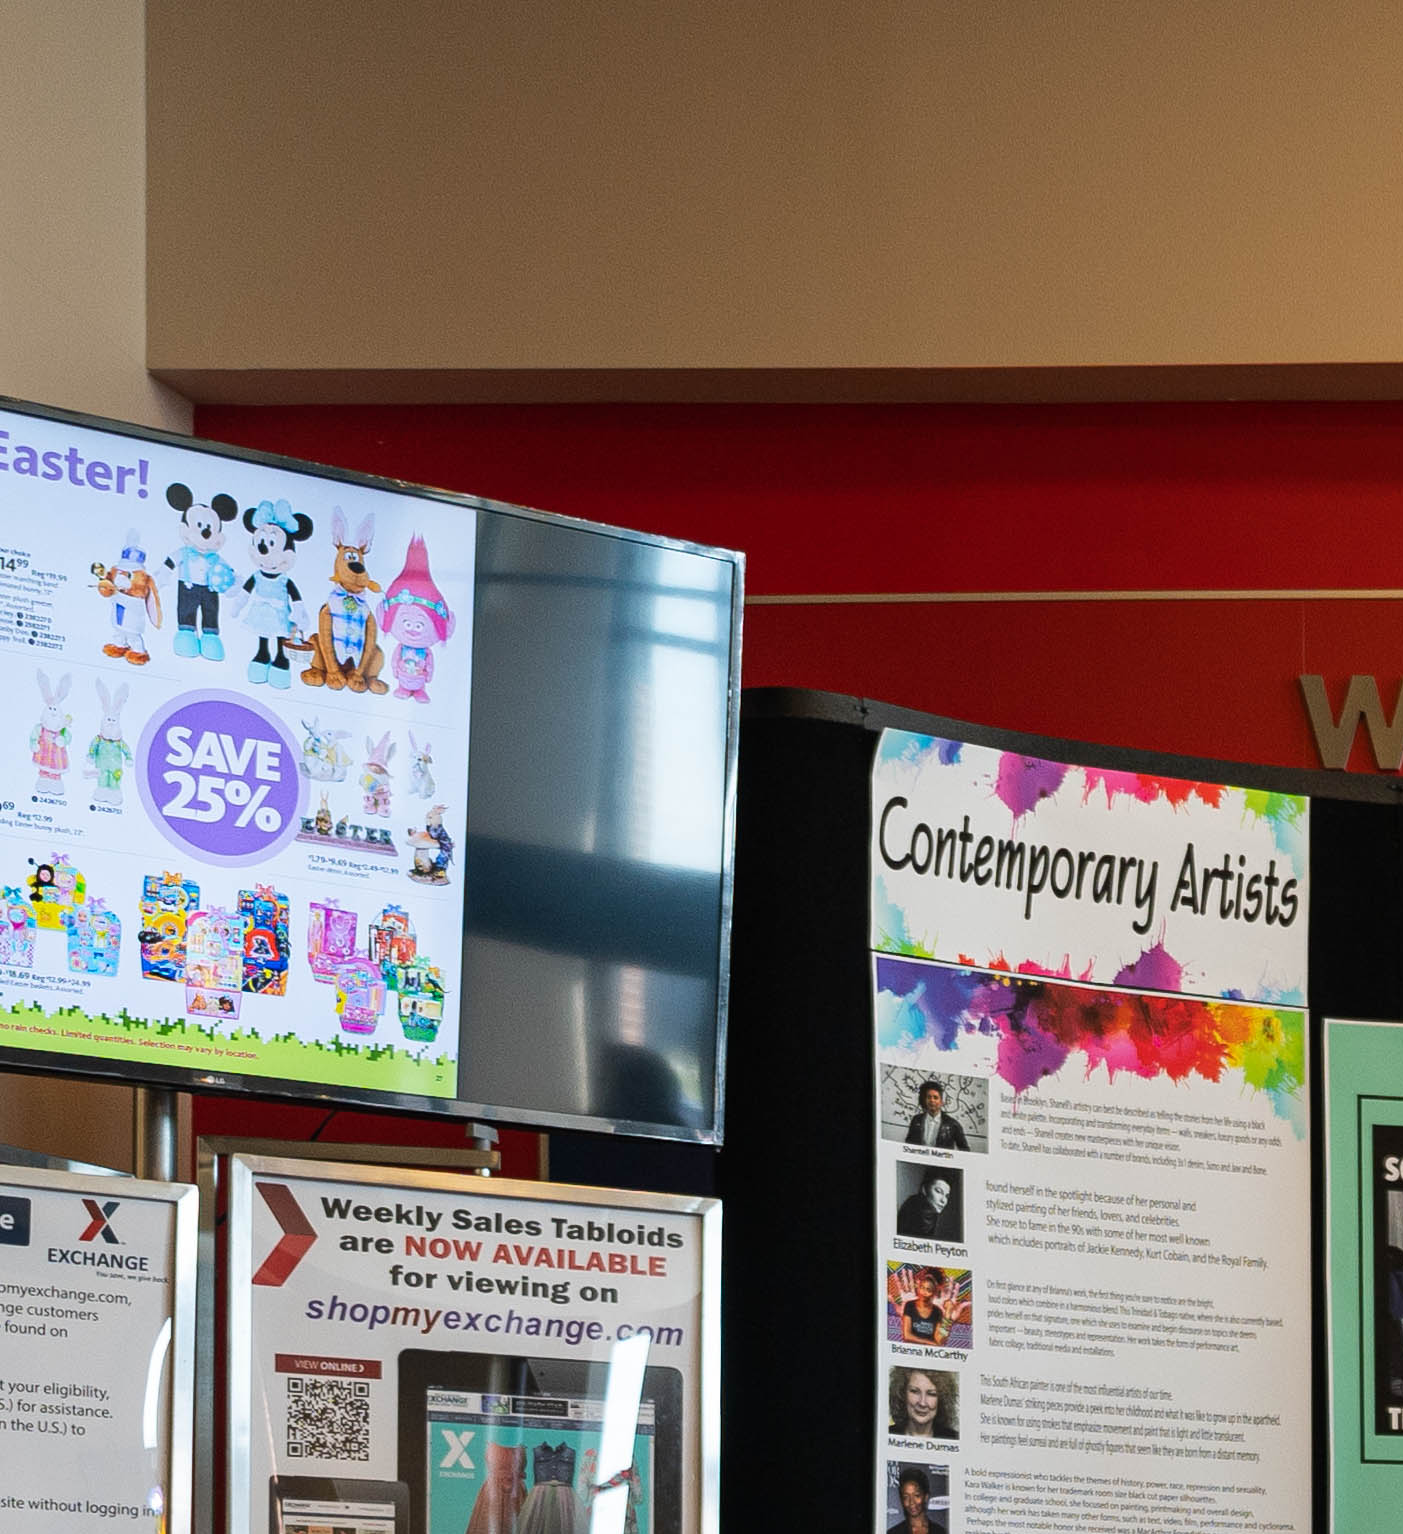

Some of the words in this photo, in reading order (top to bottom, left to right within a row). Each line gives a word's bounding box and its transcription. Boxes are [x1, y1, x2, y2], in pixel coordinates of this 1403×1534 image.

[166, 726, 282, 782] SAVE
[162, 770, 282, 832] 25%
[879, 795, 1159, 935] Contemporary
[1170, 842, 1299, 928] Artists
[61, 1029, 91, 1040] Limited
[139, 1038, 175, 1049] Selection
[1150, 1200, 1181, 1210] personal
[321, 1197, 443, 1232] Weekly
[452, 1208, 542, 1237] Sales
[552, 1217, 684, 1249] Tabloids
[340, 1234, 395, 1254] are
[405, 1236, 483, 1262] NOW
[493, 1244, 667, 1277] AVAILABLE
[893, 1238, 932, 1257] Elizabeth
[935, 1243, 968, 1259] Peyton
[47, 1248, 149, 1272] EXCHANGE
[390, 1265, 438, 1290] for
[447, 1271, 571, 1305] viewing
[579, 1282, 619, 1304] on
[27, 1305, 99, 1321] customers
[306, 1295, 684, 1346] shopmyexchange.com
[5, 1320, 45, 1335] found
[50, 1327, 67, 1337] on
[294, 1360, 319, 1371] VIEW
[320, 1362, 358, 1373] ONLINE
[17, 1400, 37, 1413] for
[40, 1403, 113, 1420] assistance.
[28, 1498, 82, 1513] without
[85, 1502, 139, 1518] logging
